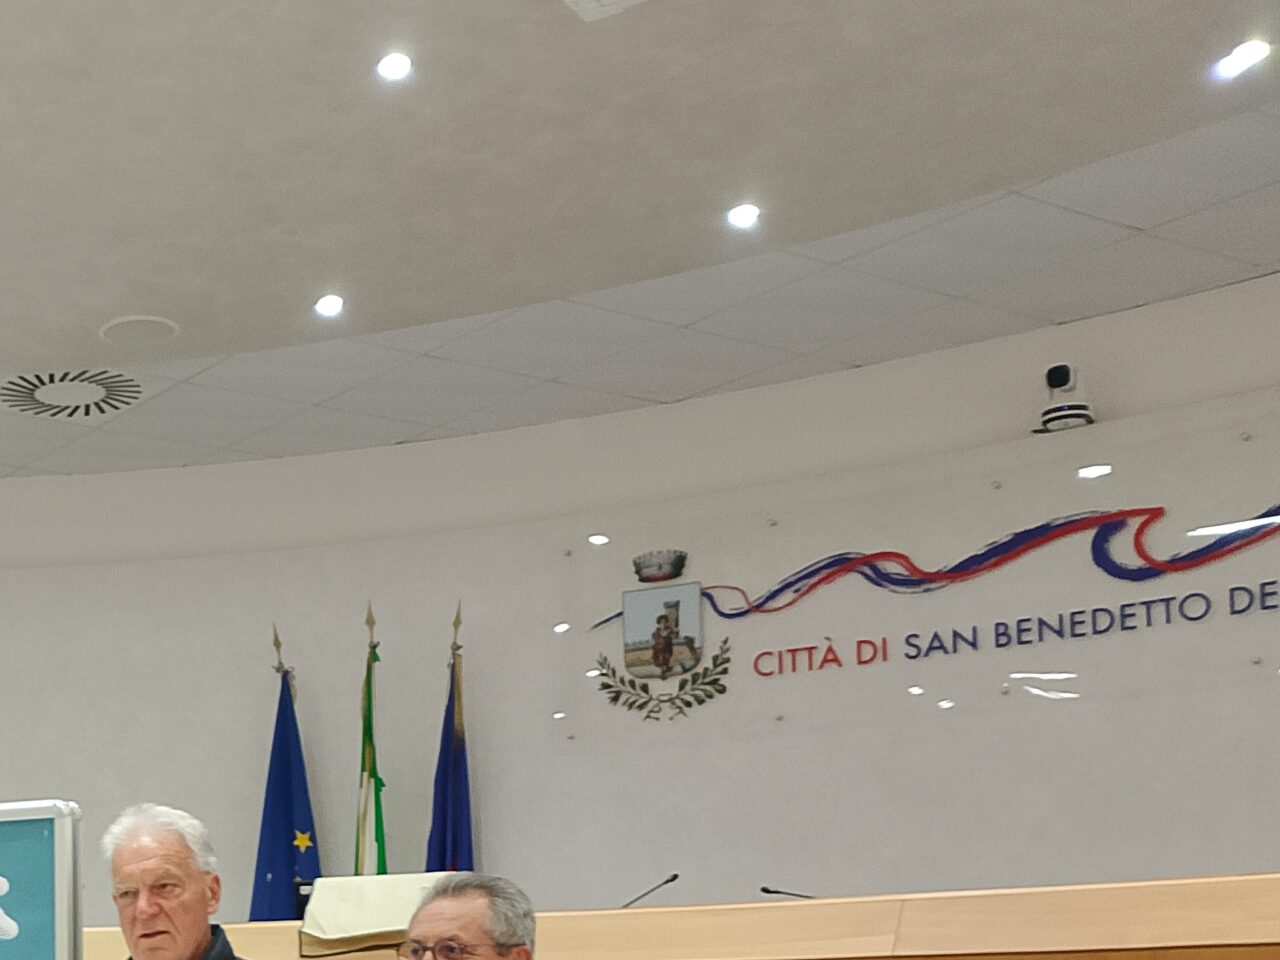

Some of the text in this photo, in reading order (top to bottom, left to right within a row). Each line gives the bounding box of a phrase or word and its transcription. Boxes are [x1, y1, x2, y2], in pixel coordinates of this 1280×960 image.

[753, 636, 842, 677] CITTÀ
[856, 637, 888, 665] DI
[904, 626, 978, 660] SAN
[994, 592, 1212, 648] BENEDETTO
